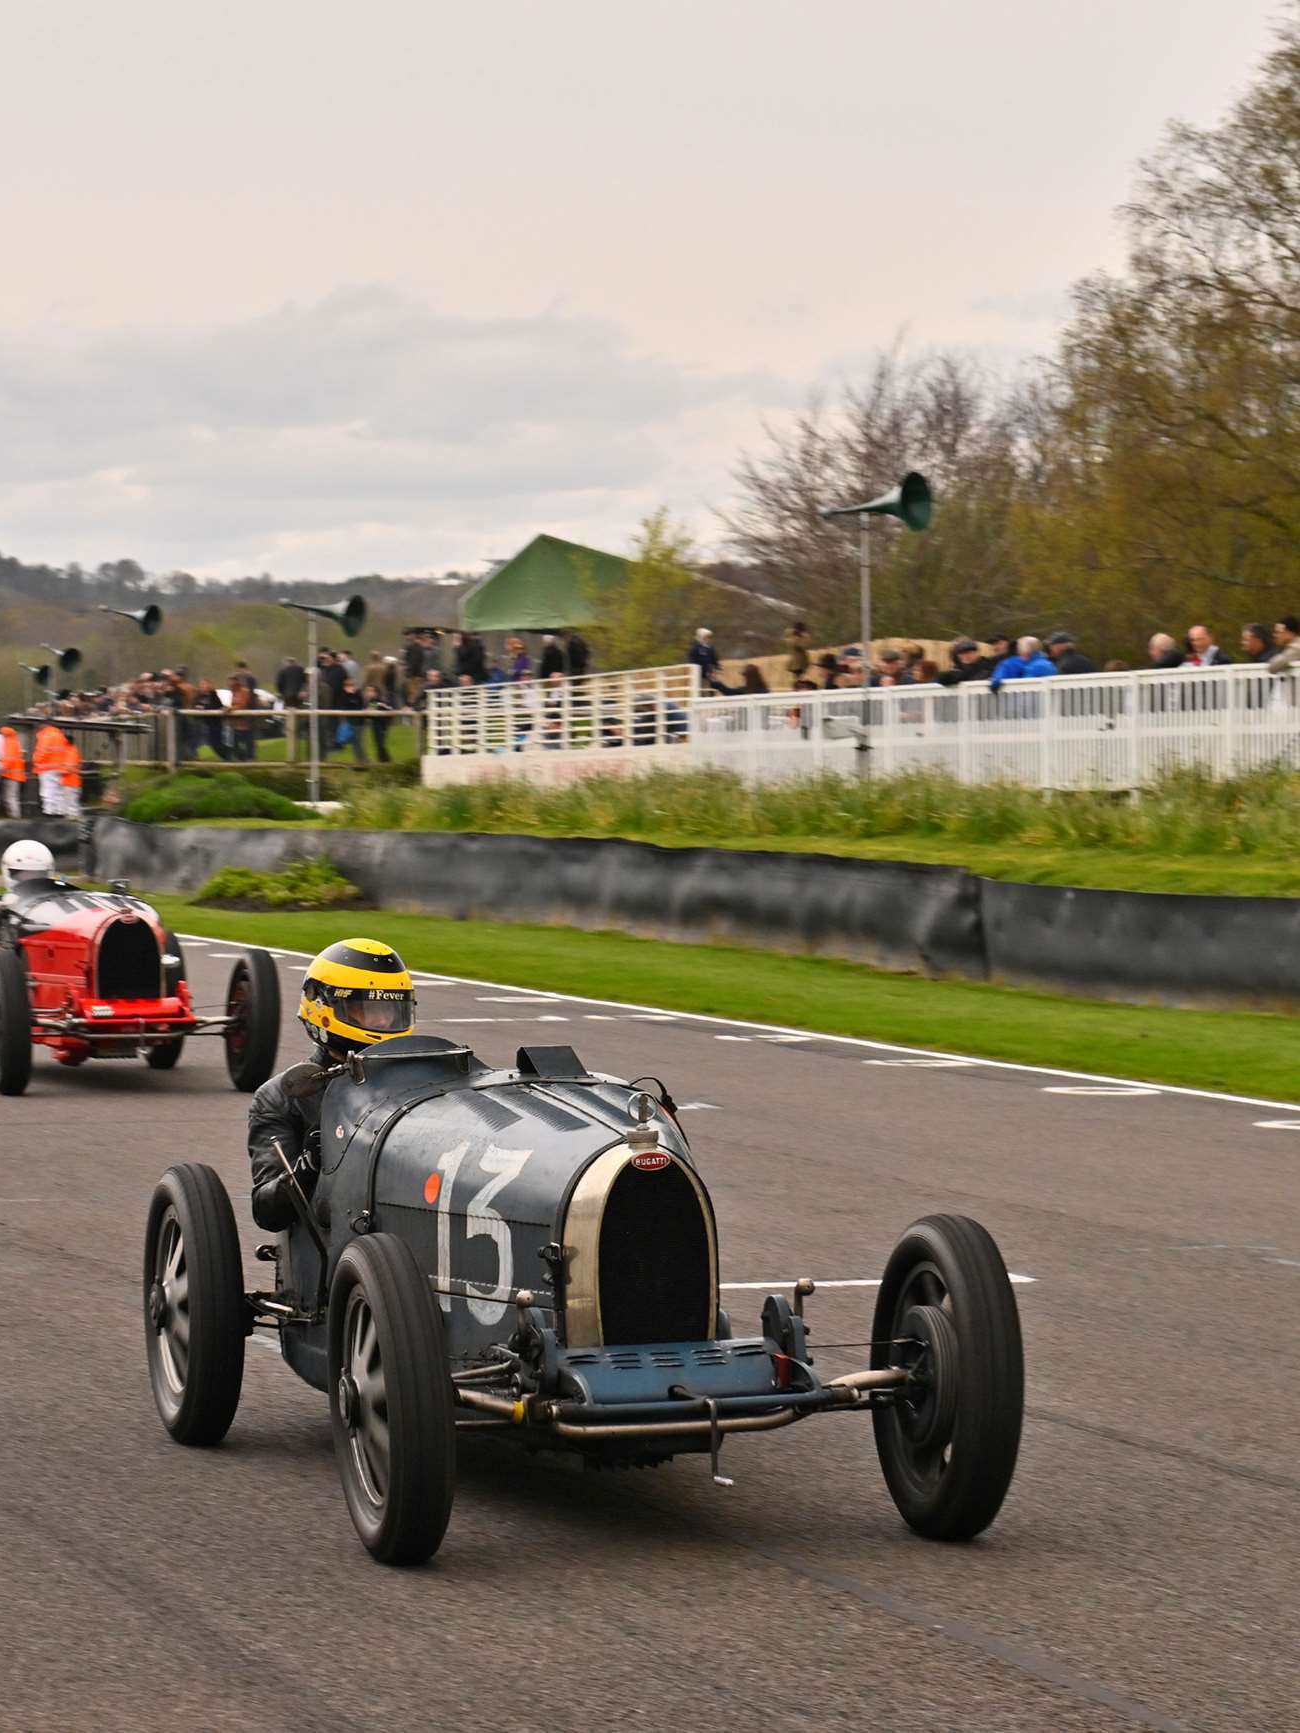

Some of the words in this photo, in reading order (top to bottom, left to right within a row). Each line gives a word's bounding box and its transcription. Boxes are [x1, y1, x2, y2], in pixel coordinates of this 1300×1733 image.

[368, 989, 405, 1000] #Fever
[635, 1157, 668, 1166] BUGATTI
[436, 1141, 534, 1327] 13
